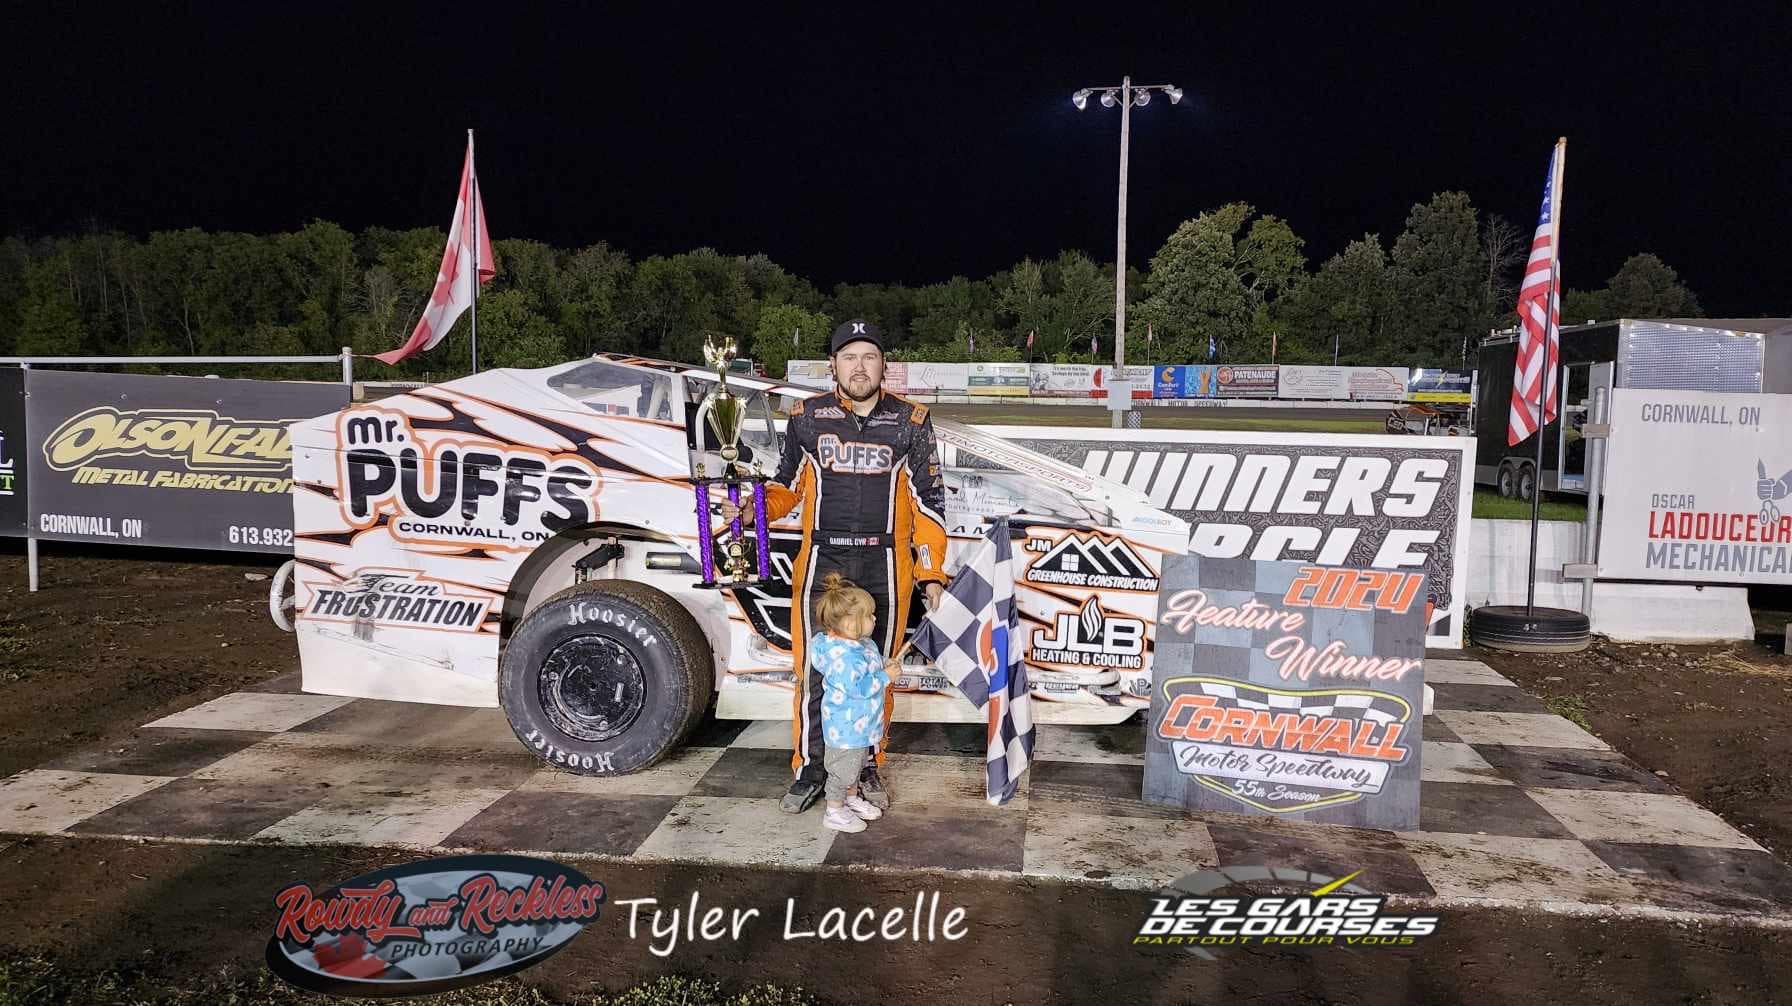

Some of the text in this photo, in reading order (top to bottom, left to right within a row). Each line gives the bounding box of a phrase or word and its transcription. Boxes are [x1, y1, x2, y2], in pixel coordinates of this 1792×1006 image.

[1234, 370, 1276, 379] PATENAUDE
[1641, 403, 1761, 425] CORNWALL, ON
[820, 445, 890, 468] PUFFS
[72, 466, 149, 486] METAL
[1081, 450, 1450, 518] WINNERS
[346, 447, 592, 533] PUFFS
[1651, 493, 1695, 509] OSCAR
[40, 514, 142, 538] CORNWALL, ON
[399, 522, 551, 543] CORNWALL, ON
[1025, 539, 1052, 552] JM
[360, 573, 440, 596] Team
[1027, 569, 1159, 590] GREENHOUSE CONSTRUCTION
[1283, 566, 1425, 614] 2024
[312, 589, 484, 627] FRUSTRATION
[1161, 589, 1307, 635] Feature
[567, 601, 658, 648] Hoosier
[1032, 613, 1145, 656] JLB
[1032, 649, 1142, 669] HEATING & COOLING
[1264, 635, 1424, 682] Winner
[1159, 694, 1408, 761] CORNWALL
[1180, 745, 1380, 791] Motor Speedway
[1232, 779, 1265, 798] 55th
